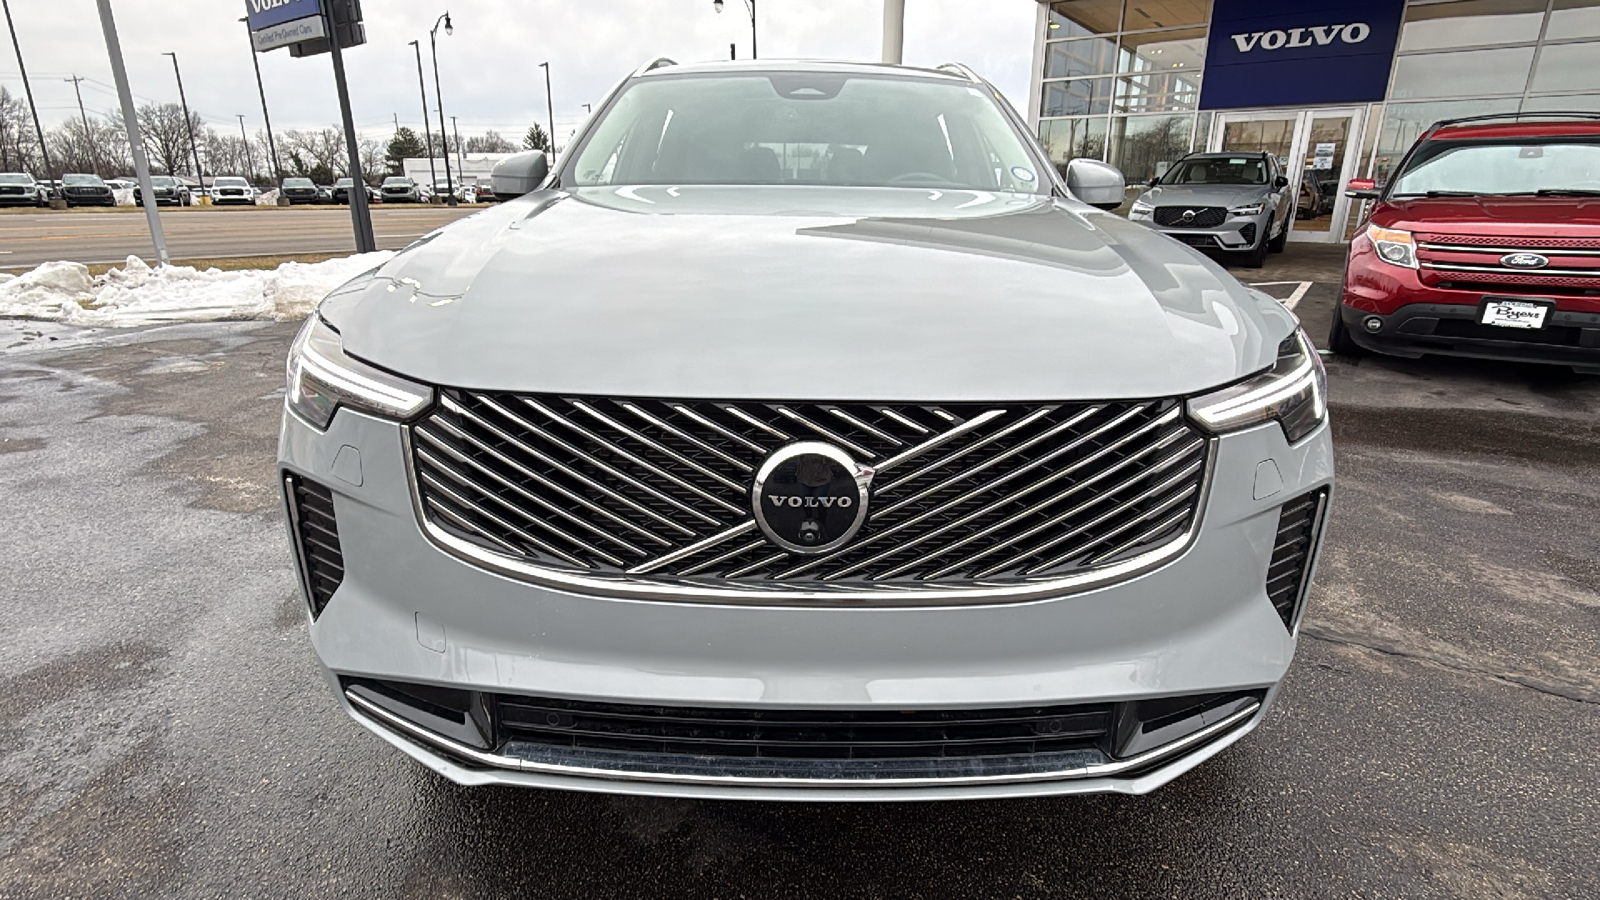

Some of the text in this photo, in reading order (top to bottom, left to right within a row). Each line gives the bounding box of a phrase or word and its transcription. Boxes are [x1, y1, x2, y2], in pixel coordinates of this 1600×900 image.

[299, 24, 313, 34] Cars
[1231, 22, 1370, 52] VOLVO
[1511, 255, 1539, 265] Ford
[1491, 305, 1541, 320] Byers
[768, 495, 853, 508] VOLVO
